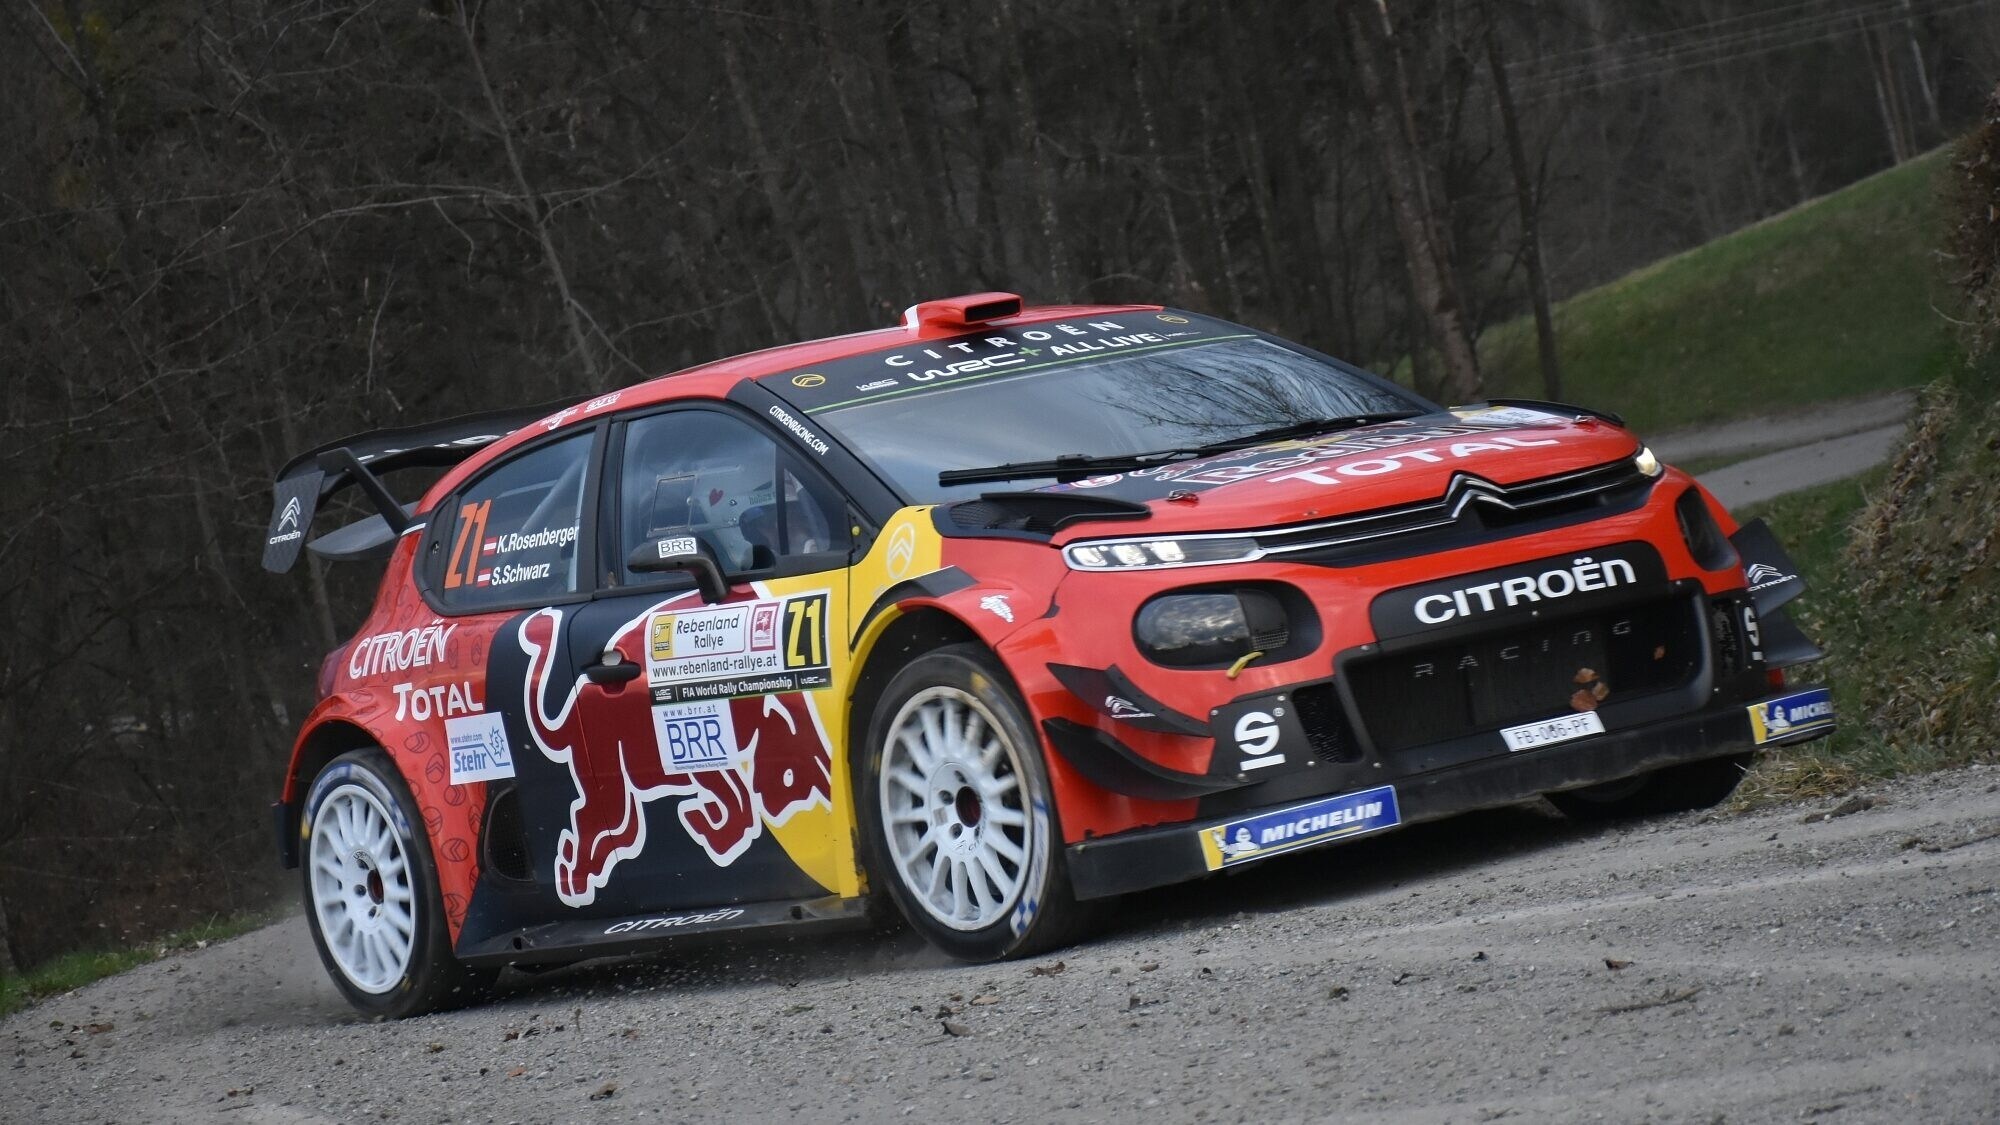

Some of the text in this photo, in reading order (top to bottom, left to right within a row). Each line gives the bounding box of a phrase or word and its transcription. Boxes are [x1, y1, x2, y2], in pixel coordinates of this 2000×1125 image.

[885, 321, 1125, 367] CITROËN
[1049, 339, 1096, 357] ALL
[1098, 332, 1162, 350] LIVE
[769, 405, 829, 456] CITROENRACING.COM
[1266, 437, 1560, 485] TOTAL
[496, 525, 580, 554] K.Rosenberger
[660, 539, 695, 553] BRR
[491, 562, 551, 586] S.Schwarz
[676, 614, 740, 635] Rebenland
[349, 619, 458, 679] CITROËN
[694, 633, 724, 651] Rallye
[652, 653, 778, 678] www.rebenland-rallye.at
[682, 686, 695, 698] FIA
[695, 683, 718, 697] World
[718, 681, 737, 696] Rally
[738, 677, 793, 693] Championship
[662, 703, 717, 718] www.brr.at
[666, 719, 727, 760] BRR
[454, 750, 487, 774] Stehr
[1260, 801, 1383, 844] MICHELIN
[604, 908, 745, 935] CITROËN
